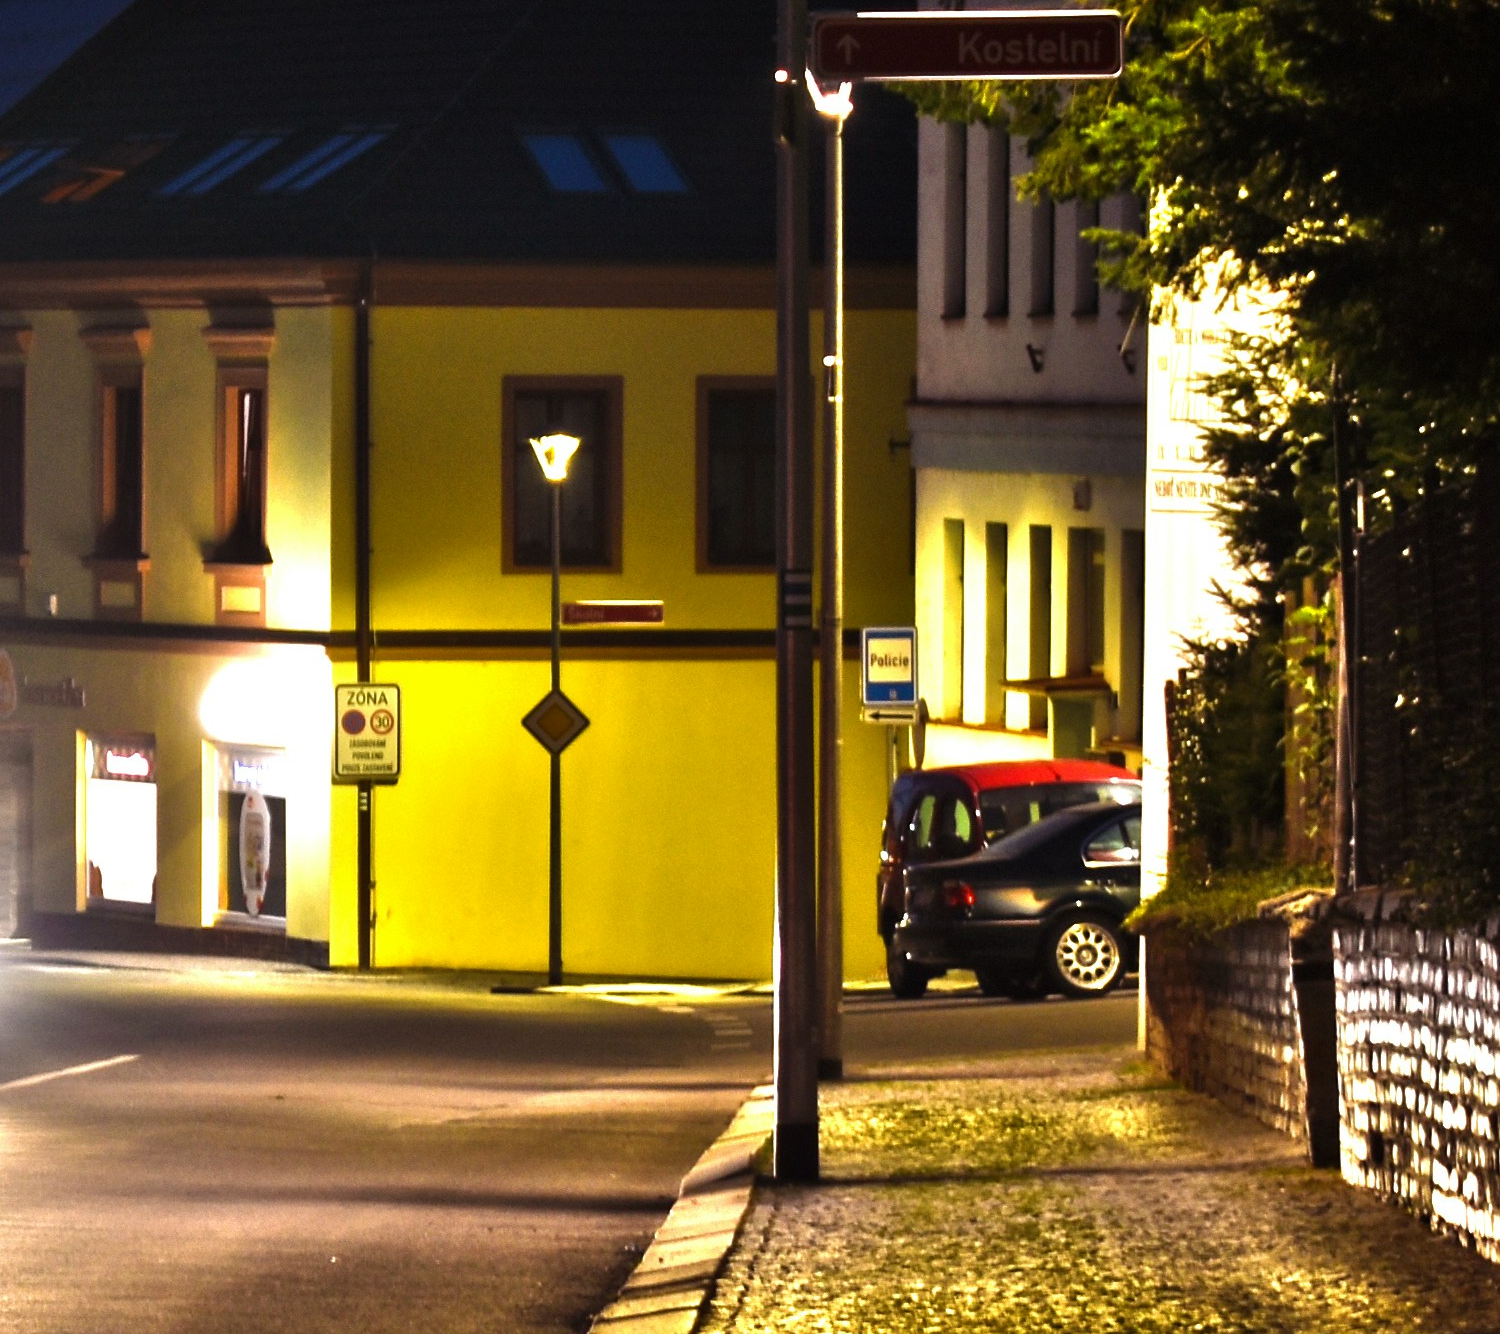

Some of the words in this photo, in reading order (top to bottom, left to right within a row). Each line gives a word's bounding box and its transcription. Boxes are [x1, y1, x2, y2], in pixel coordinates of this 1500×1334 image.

[958, 30, 1102, 65] Kostelní
[870, 653, 909, 667] Policie
[347, 688, 388, 706] ZÓNA
[375, 716, 390, 729] 30
